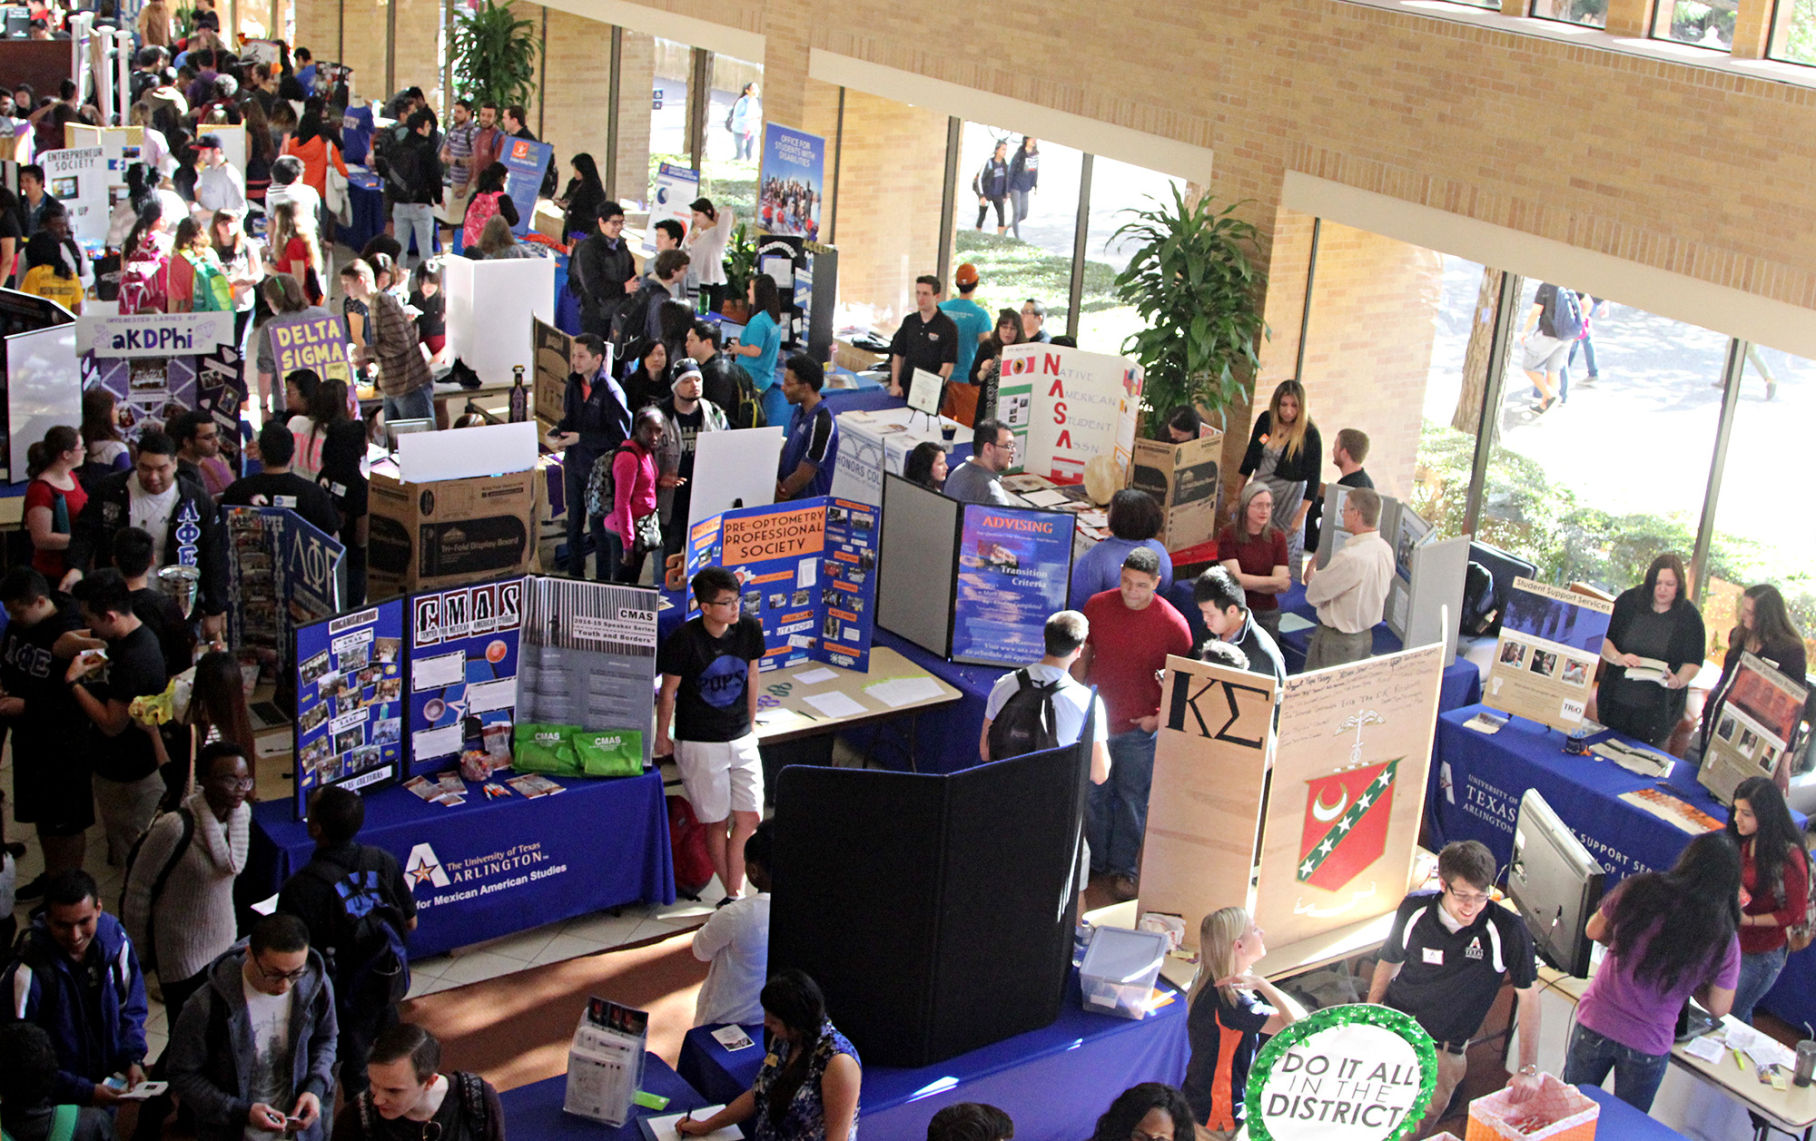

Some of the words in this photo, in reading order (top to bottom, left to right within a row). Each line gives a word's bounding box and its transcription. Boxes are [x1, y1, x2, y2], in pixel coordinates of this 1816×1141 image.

[47, 147, 103, 162] ENTREPRENEUR
[781, 135, 799, 146] OFFICE
[55, 159, 94, 171] SOCIETY
[112, 328, 193, 350] aKDPhi
[276, 319, 341, 347] DELTA
[281, 342, 344, 369] SIGMA
[1043, 352, 1094, 382] NATIVE
[1048, 379, 1117, 407] AMERICAN
[1053, 402, 1112, 432] STUDENT
[725, 523, 823, 545] PROFESSIONAL
[982, 515, 1054, 534] ADVISING
[441, 542, 469, 554] Tri-Fold
[497, 536, 519, 547] Board
[740, 538, 806, 559] SOCIETY
[1001, 565, 1048, 578] Transition
[1012, 577, 1048, 588] Criteria
[1516, 578, 1546, 593] Student
[1547, 587, 1577, 602] Support
[1578, 595, 1611, 612] Services
[417, 584, 520, 642] CMAS
[603, 621, 631, 630] Speaker
[633, 625, 655, 633] Series
[620, 610, 654, 621] CMAS
[535, 732, 560, 741] CMAS
[594, 736, 621, 745] CMAS
[1465, 784, 1517, 823] TEXAS
[1468, 774, 1508, 800] UNIVERSITY
[1509, 796, 1519, 805] OF
[1462, 802, 1514, 834] ARLINGTON
[446, 863, 462, 872] The
[464, 852, 504, 868] University
[507, 847, 516, 856] of
[518, 842, 541, 853] Texas
[1580, 833, 1629, 866] SUPPORT
[453, 850, 542, 884] ARLINGTON
[416, 899, 432, 910] for
[434, 888, 478, 906] Mexican
[480, 876, 528, 895] American
[530, 864, 567, 881] Studies
[1282, 1052, 1330, 1076] DO
[1337, 1057, 1363, 1079] IT
[1367, 1062, 1414, 1085] ALL
[1289, 1075, 1322, 1095] IN
[1337, 1080, 1392, 1103] THE
[1266, 1093, 1404, 1128] DISTRICT
